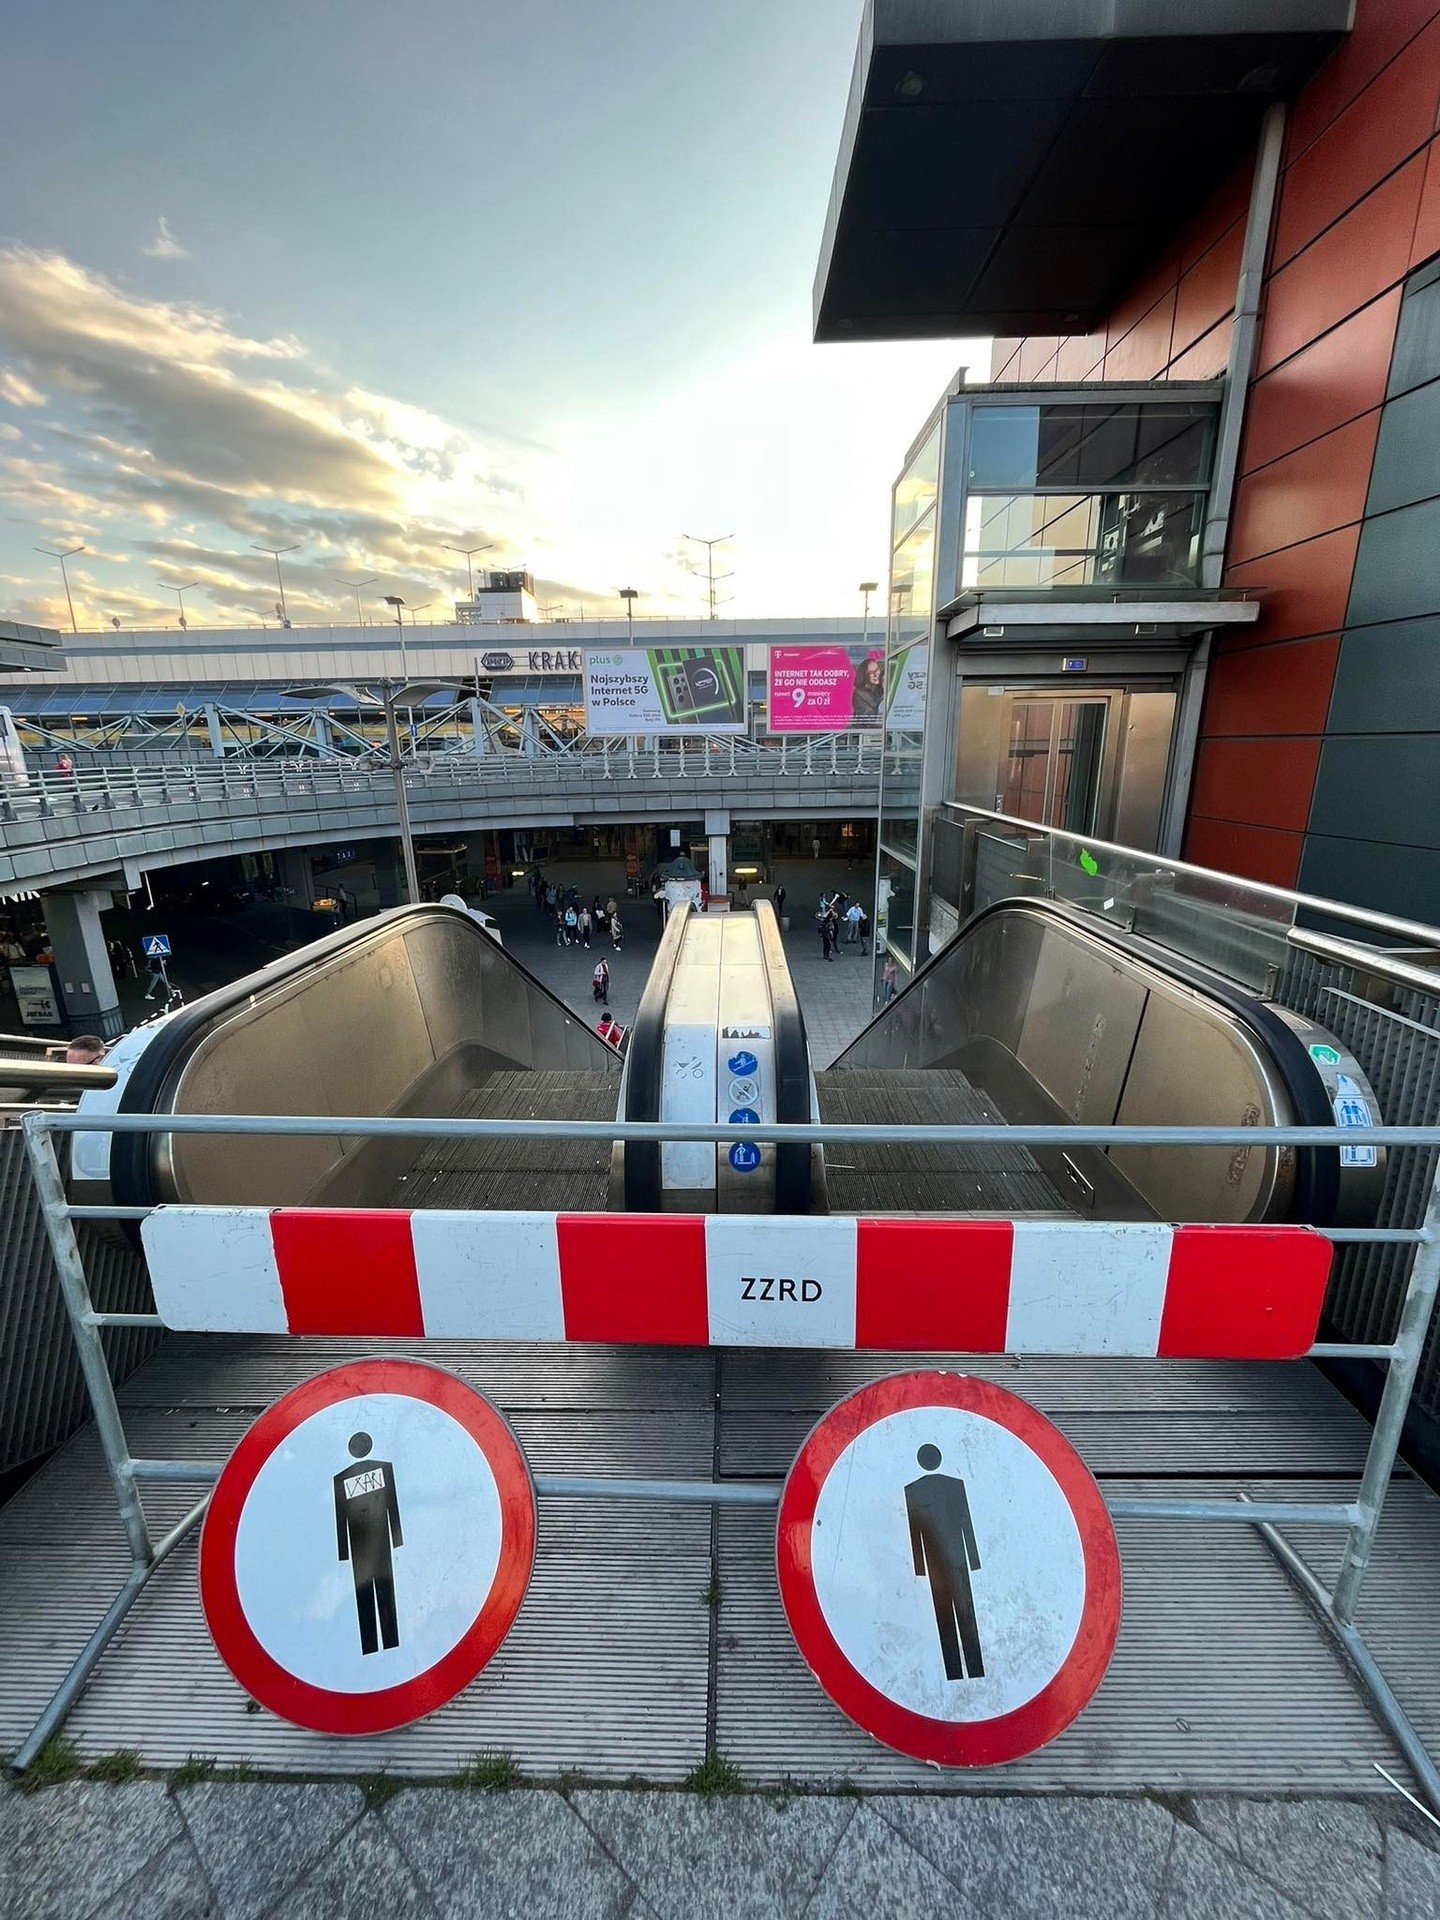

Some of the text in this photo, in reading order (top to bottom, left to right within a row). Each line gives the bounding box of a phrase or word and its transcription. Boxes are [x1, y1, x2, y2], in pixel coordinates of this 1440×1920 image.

[528, 651, 582, 671] KRAK
[589, 656, 611, 666] plus
[774, 670, 808, 678] INTERNET
[823, 670, 850, 678] DOBRY,
[590, 674, 649, 685] Najszybszy
[784, 678, 796, 686] GO
[796, 678, 808, 686] NIE
[808, 678, 838, 686] ODDASZ
[591, 685, 649, 695] Internet 5G
[603, 697, 636, 706] Polsce
[792, 688, 806, 708] 9
[816, 696, 823, 706] 0
[741, 1278, 822, 1301] ZZRD
